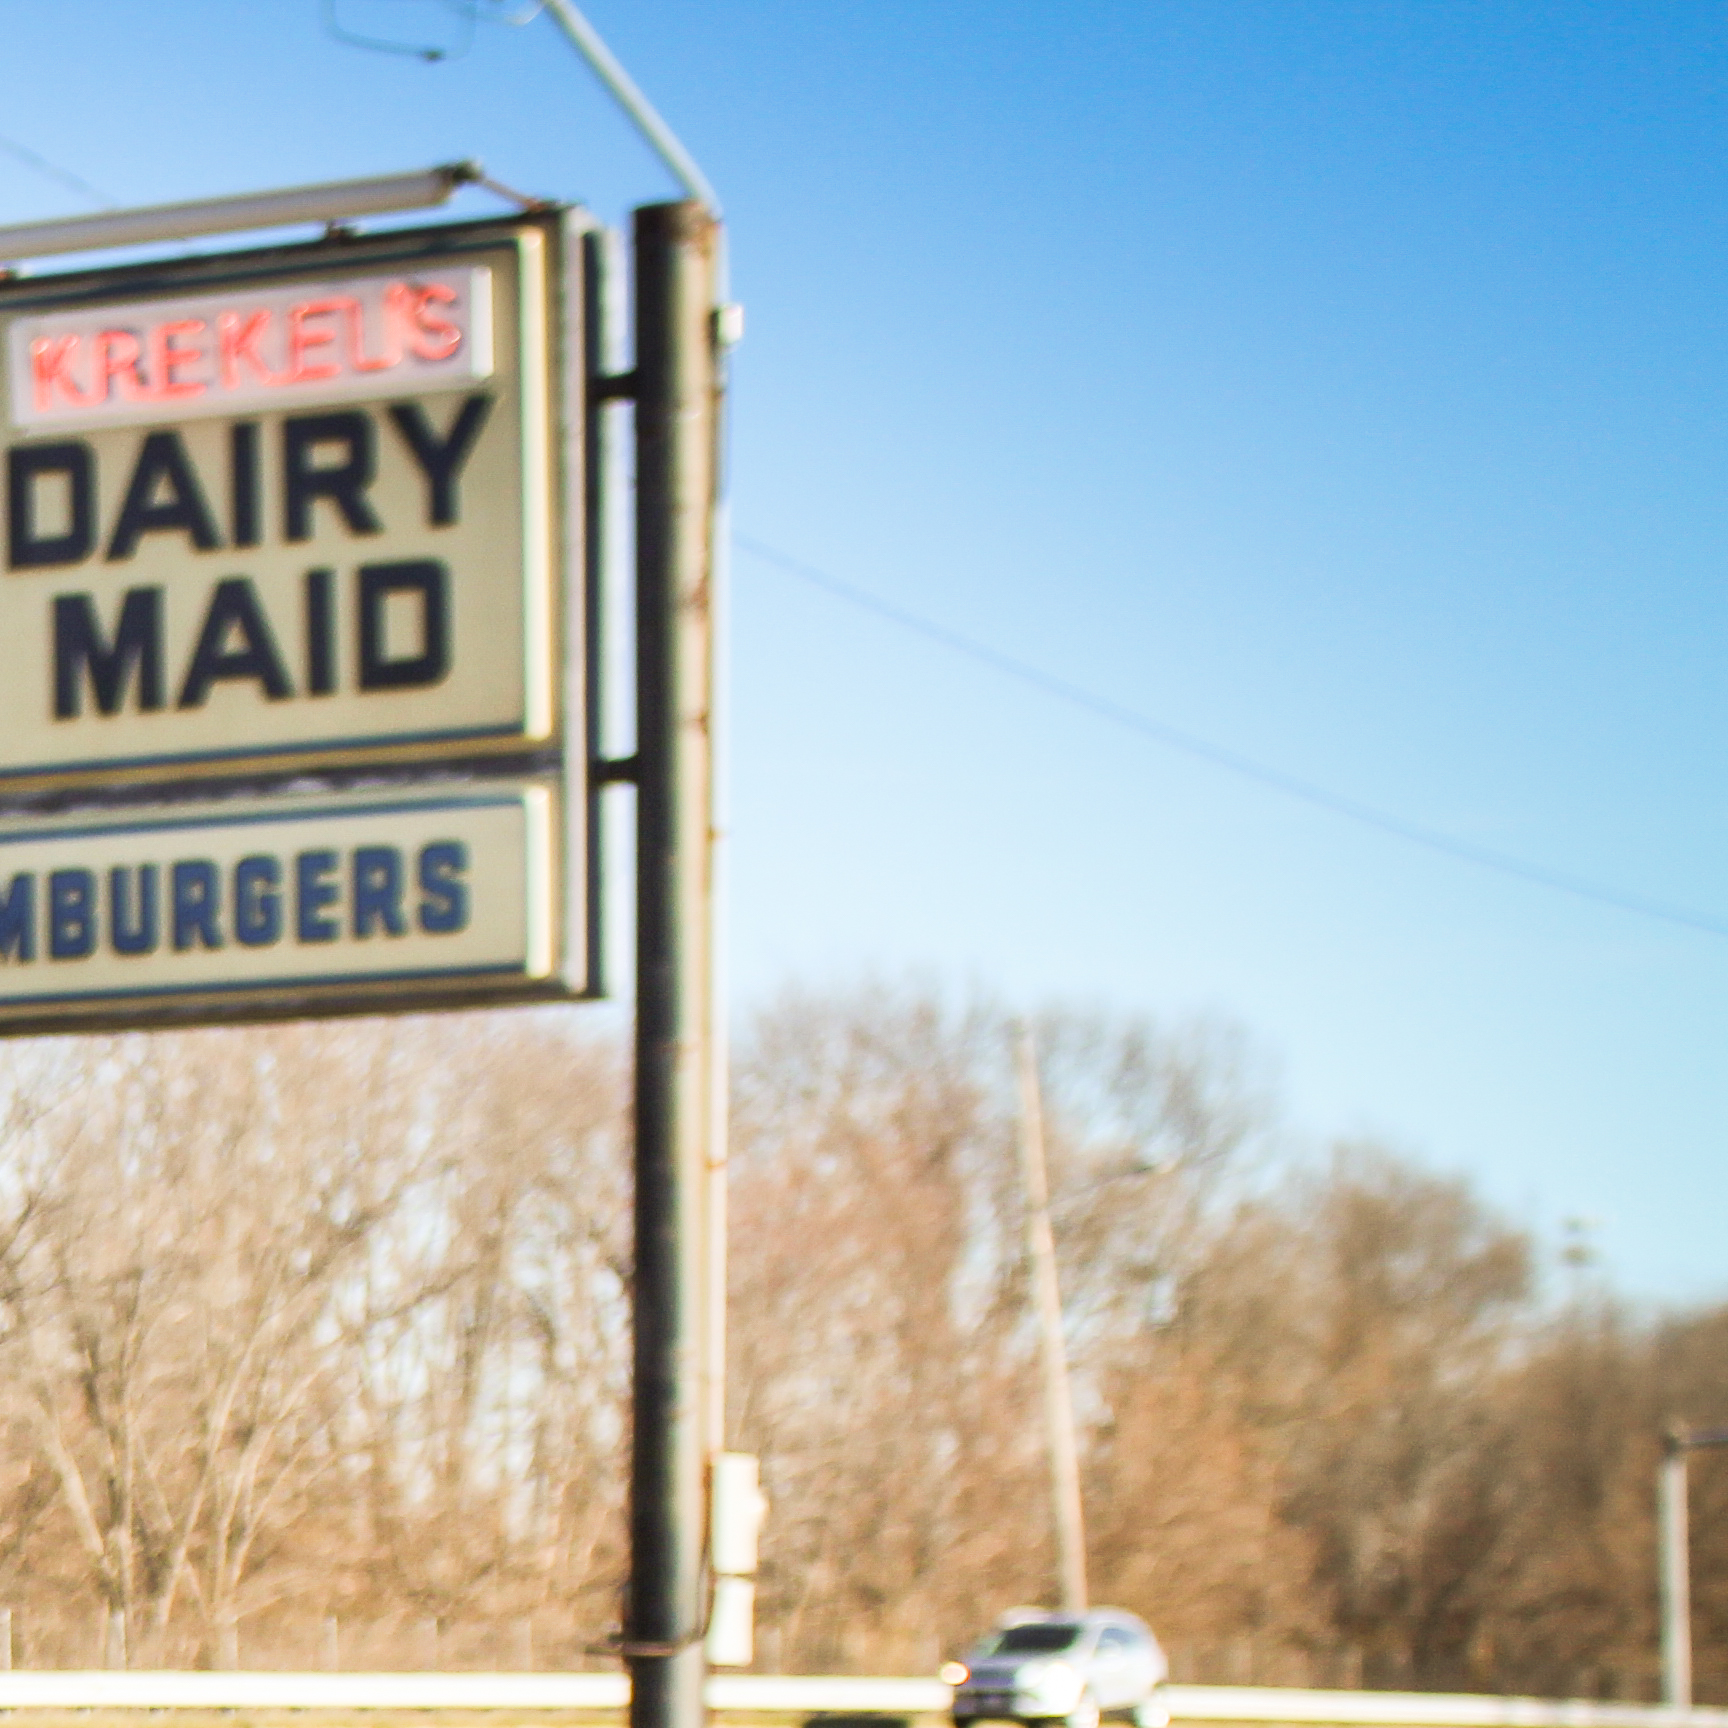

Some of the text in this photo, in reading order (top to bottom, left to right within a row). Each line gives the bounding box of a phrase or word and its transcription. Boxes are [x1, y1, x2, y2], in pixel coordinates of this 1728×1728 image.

[26, 280, 464, 414] KREKEL'S
[3, 392, 499, 571] DAIRY
[50, 557, 452, 722] MAID
